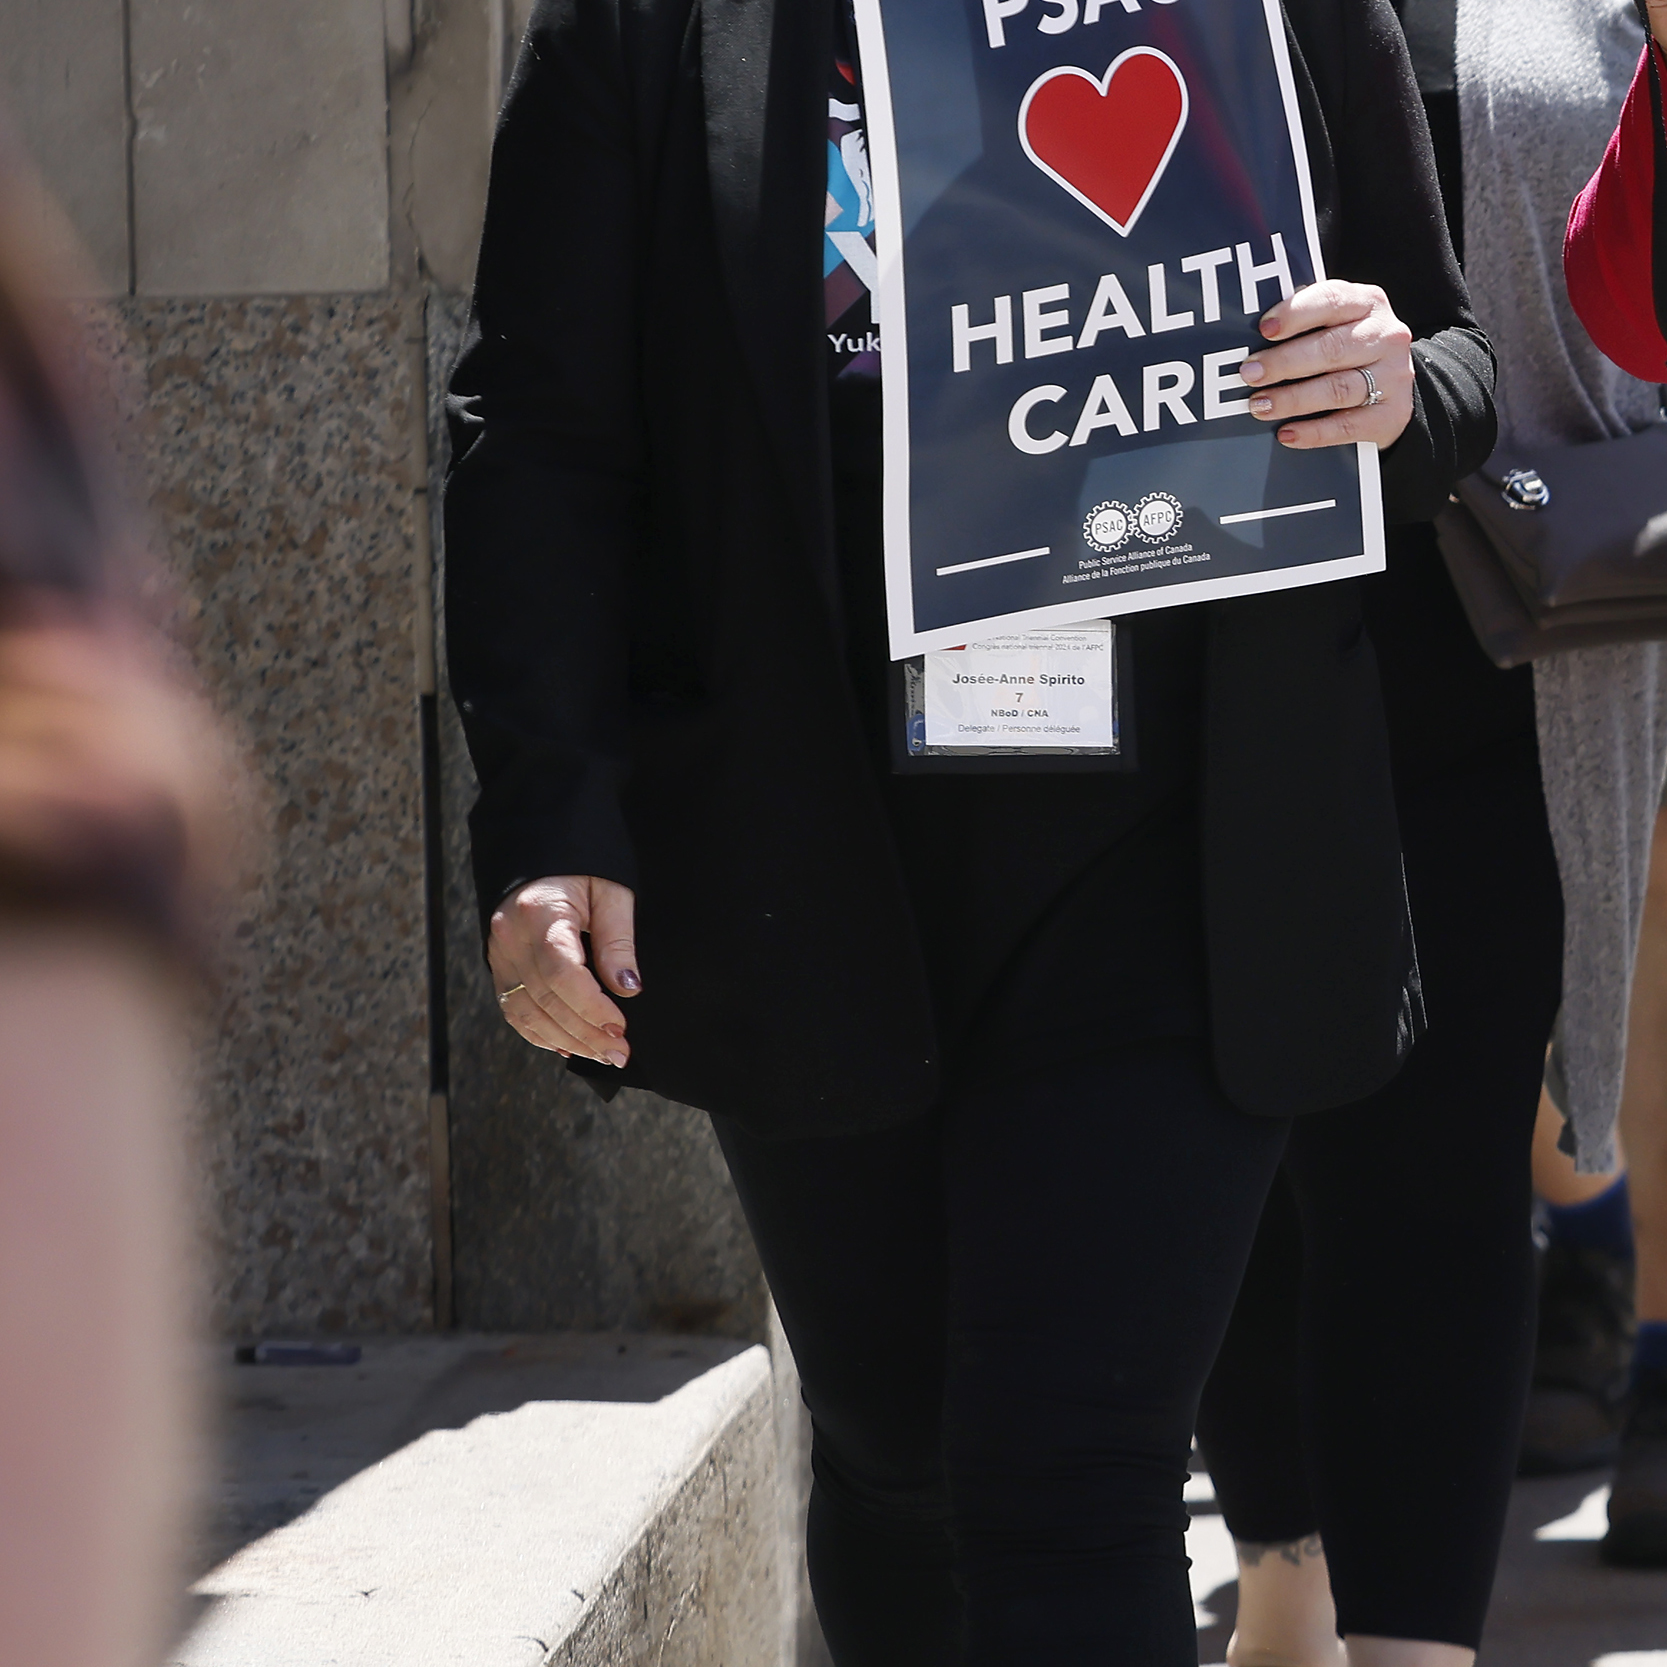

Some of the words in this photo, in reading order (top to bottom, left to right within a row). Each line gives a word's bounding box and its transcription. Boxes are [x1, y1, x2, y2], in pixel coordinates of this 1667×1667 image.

[950, 232, 1295, 374] HEALTH
[826, 331, 882, 353] Yuk
[1008, 346, 1251, 455] CARE
[1095, 519, 1124, 535] PSAC
[1143, 510, 1172, 527] AFPC
[1078, 558, 1101, 570] Public
[1101, 554, 1127, 566] Service
[1128, 550, 1156, 562] Alliance
[1157, 547, 1164, 556] of
[1165, 542, 1194, 554] Canada
[1062, 572, 1091, 584] Alliance
[1091, 570, 1101, 579] de
[1102, 568, 1109, 577] la
[1110, 563, 1139, 576] Fonction
[1140, 559, 1171, 572] publique
[1172, 556, 1182, 566] du
[1182, 552, 1211, 564] Canada
[952, 672, 1035, 685] Josée-Anne
[1039, 674, 1086, 686] Spirito
[1015, 692, 1024, 703] 7
[991, 709, 1019, 718] NBoD
[1027, 709, 1049, 718] CNA
[957, 723, 995, 734] Delegate
[1003, 724, 1042, 733] Personne
[1043, 723, 1081, 734] déléguée
